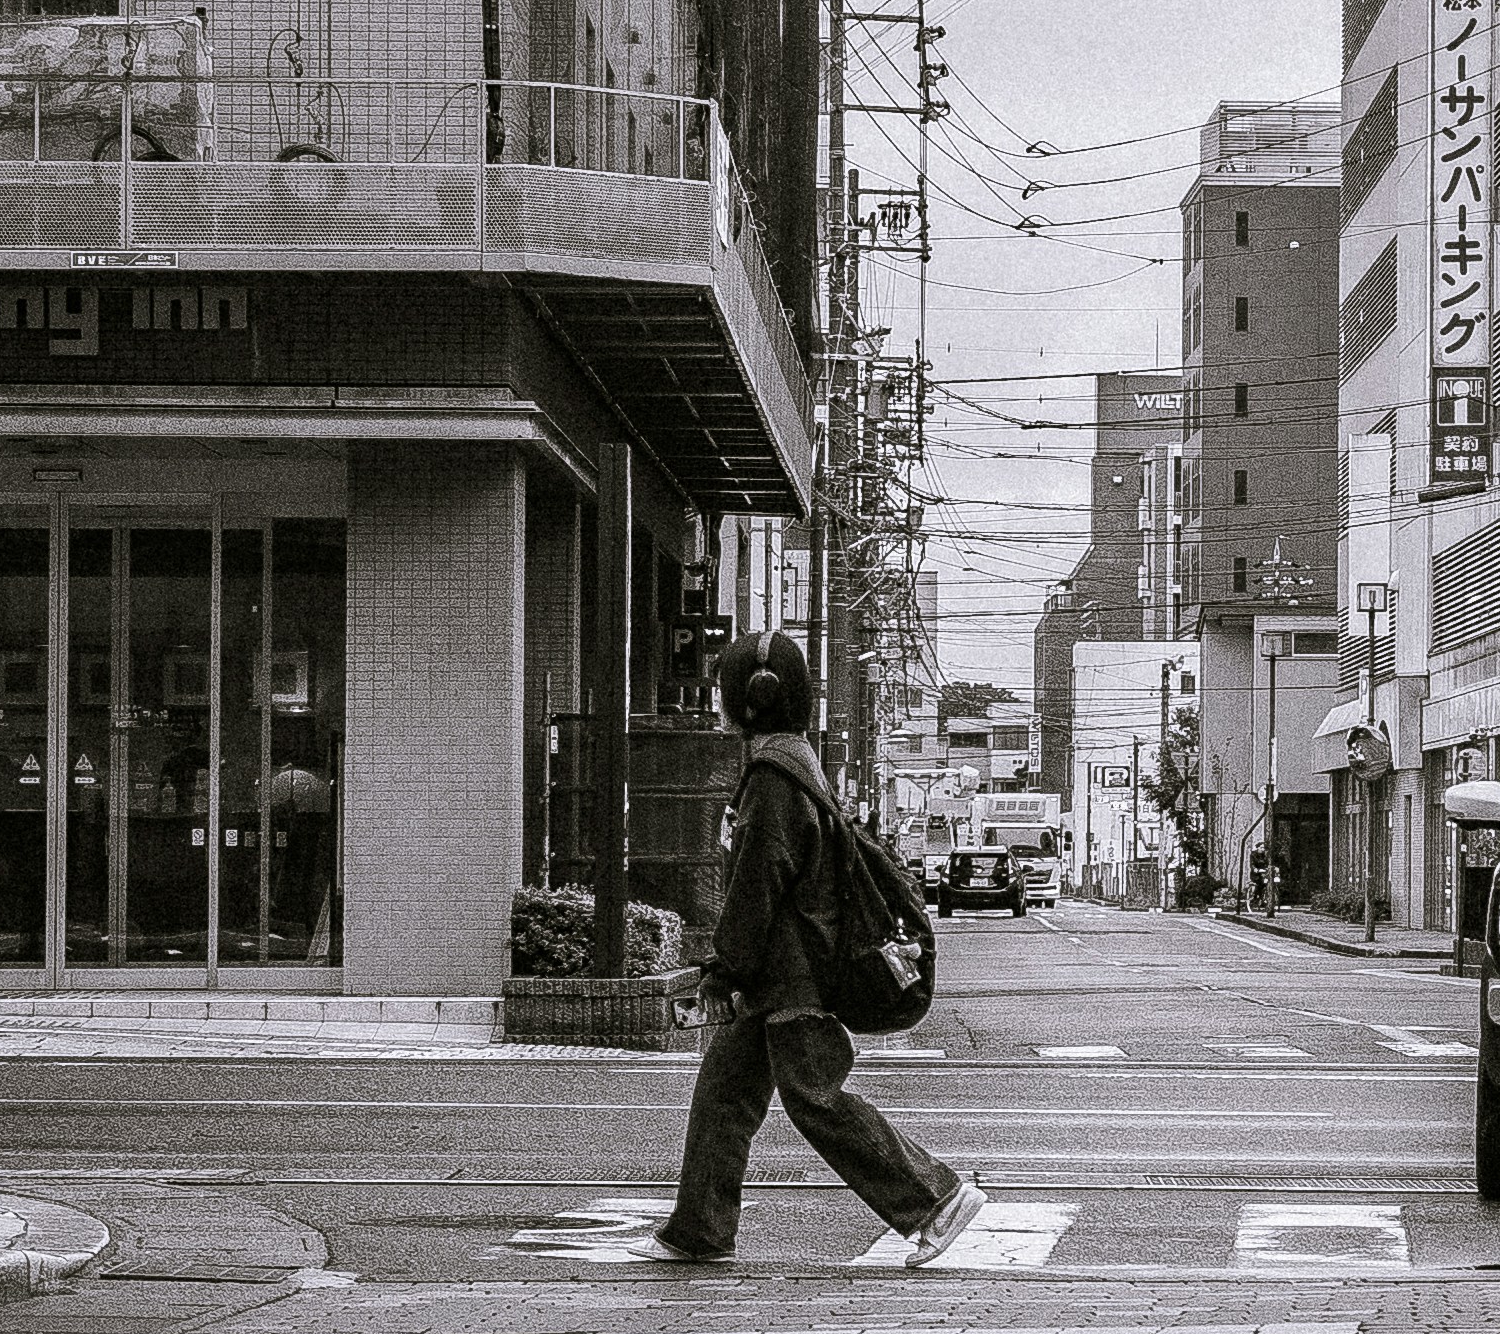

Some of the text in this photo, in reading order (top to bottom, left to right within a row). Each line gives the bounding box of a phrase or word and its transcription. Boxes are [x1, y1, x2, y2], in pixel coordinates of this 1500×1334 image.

[1440, 17, 1485, 355] ノーサンパーキング
[1443, 435, 1479, 452] 契約
[1435, 455, 1488, 473] 駐車場
